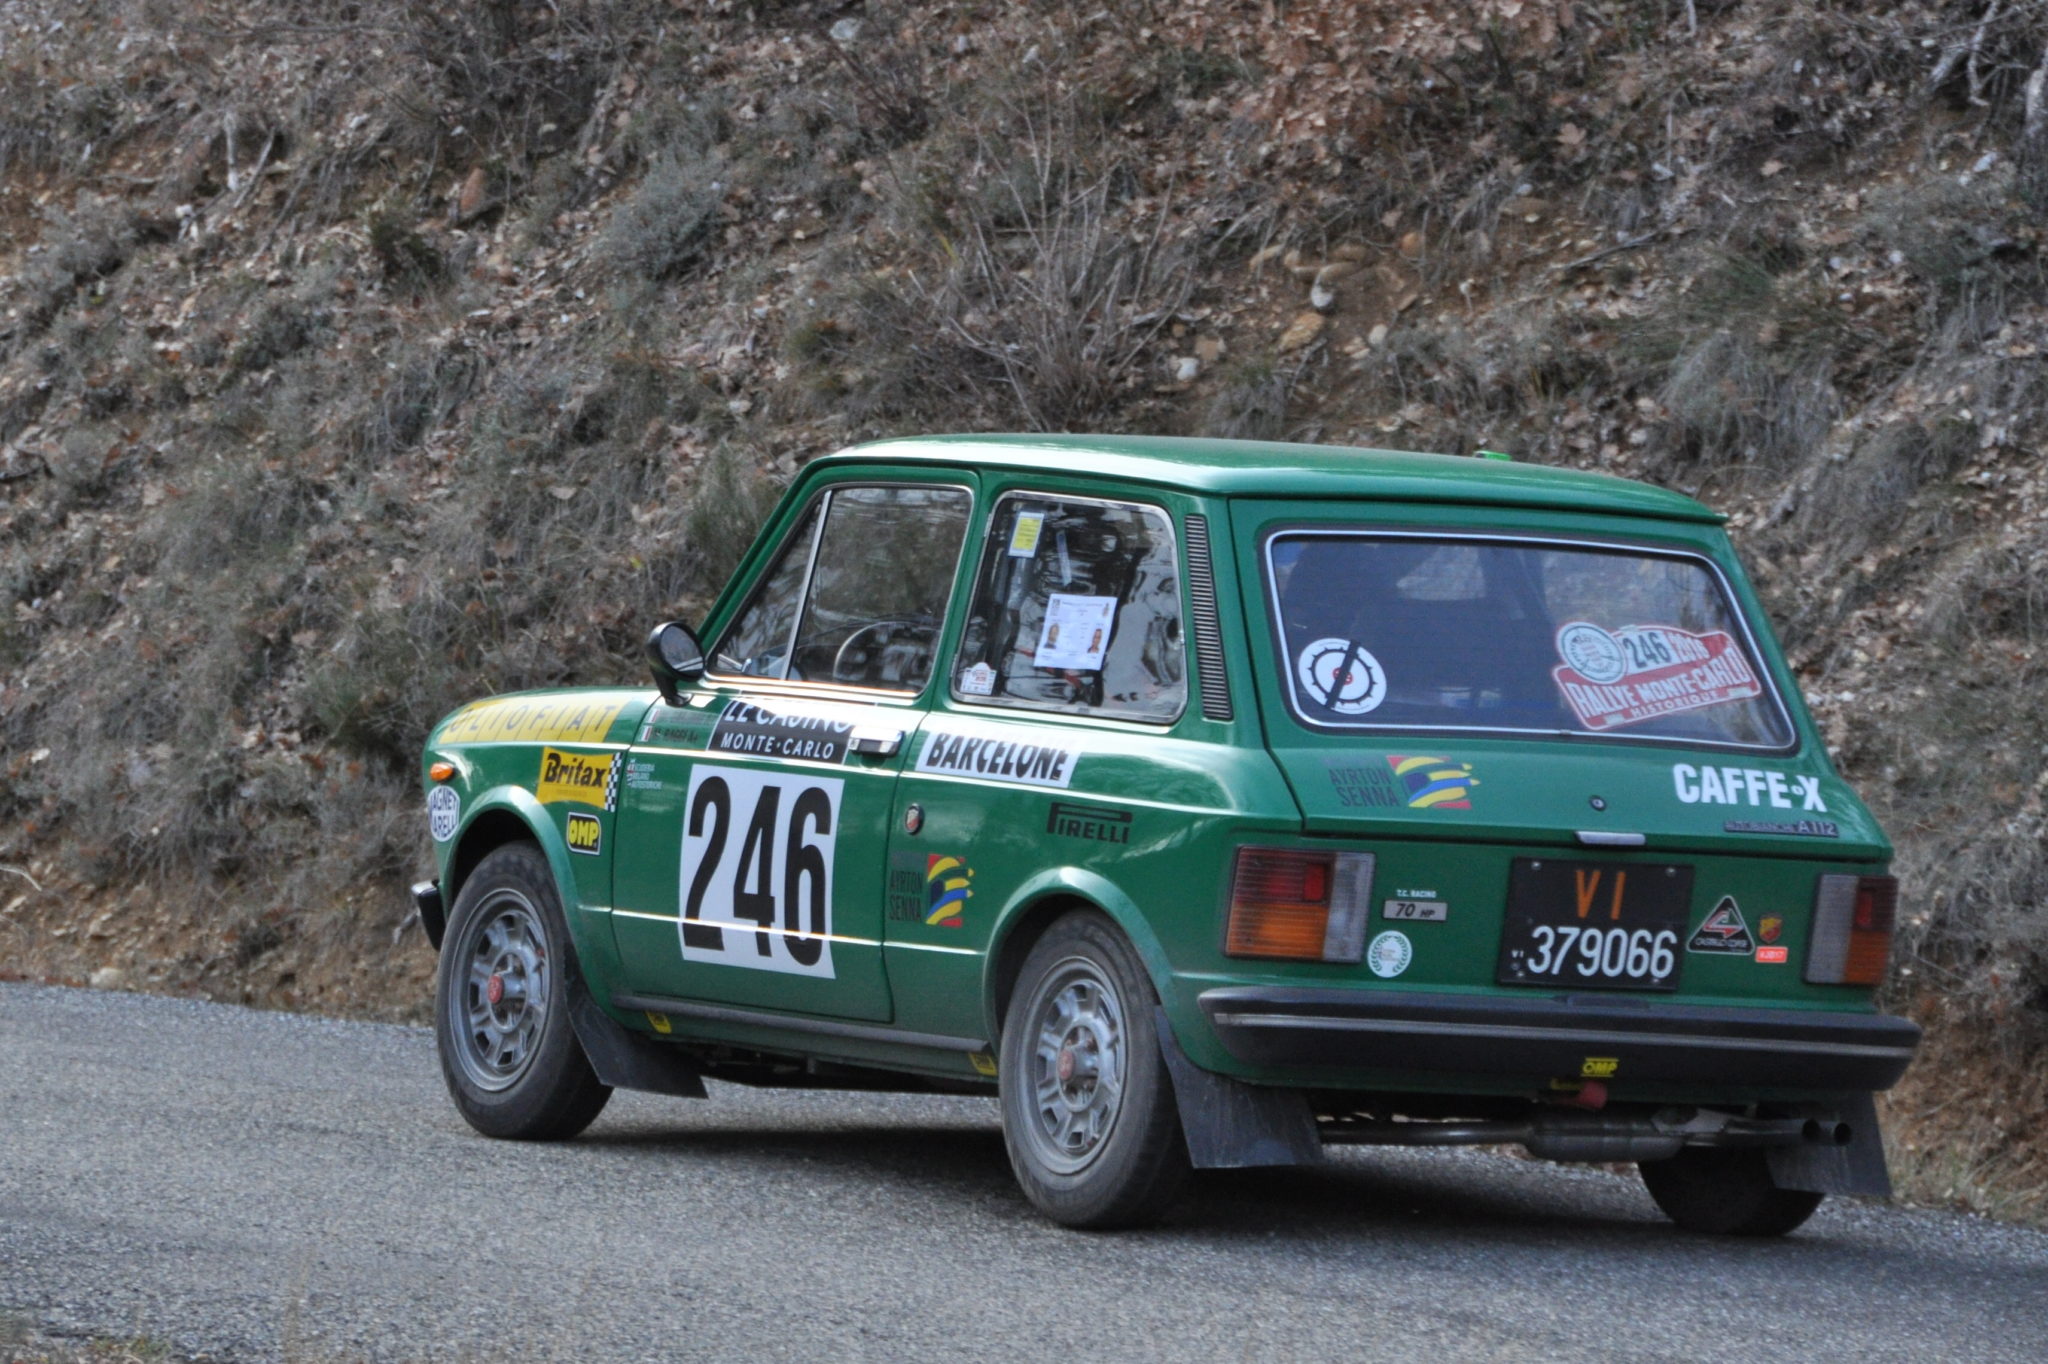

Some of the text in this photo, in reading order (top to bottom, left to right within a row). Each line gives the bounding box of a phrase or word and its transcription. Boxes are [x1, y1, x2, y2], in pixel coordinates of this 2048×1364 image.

[1623, 632, 1671, 668] 246
[1565, 681, 1639, 718] RALLYE
[1631, 691, 1718, 717] HISTORIQUE
[544, 752, 607, 788] Britax
[926, 732, 1069, 781] BARCELONE
[1329, 768, 1392, 785] AYRTON
[1336, 786, 1399, 807] SENNA
[569, 819, 599, 847] OMP
[1046, 802, 1133, 844] PIRELLI
[1798, 820, 1836, 835] A112
[682, 775, 832, 966] 246
[889, 870, 923, 894] AYRTON
[889, 895, 922, 922] SENNA
[1395, 903, 1416, 917] 70
[1527, 925, 1678, 979] 379066
[1583, 1061, 1617, 1075] OMP
